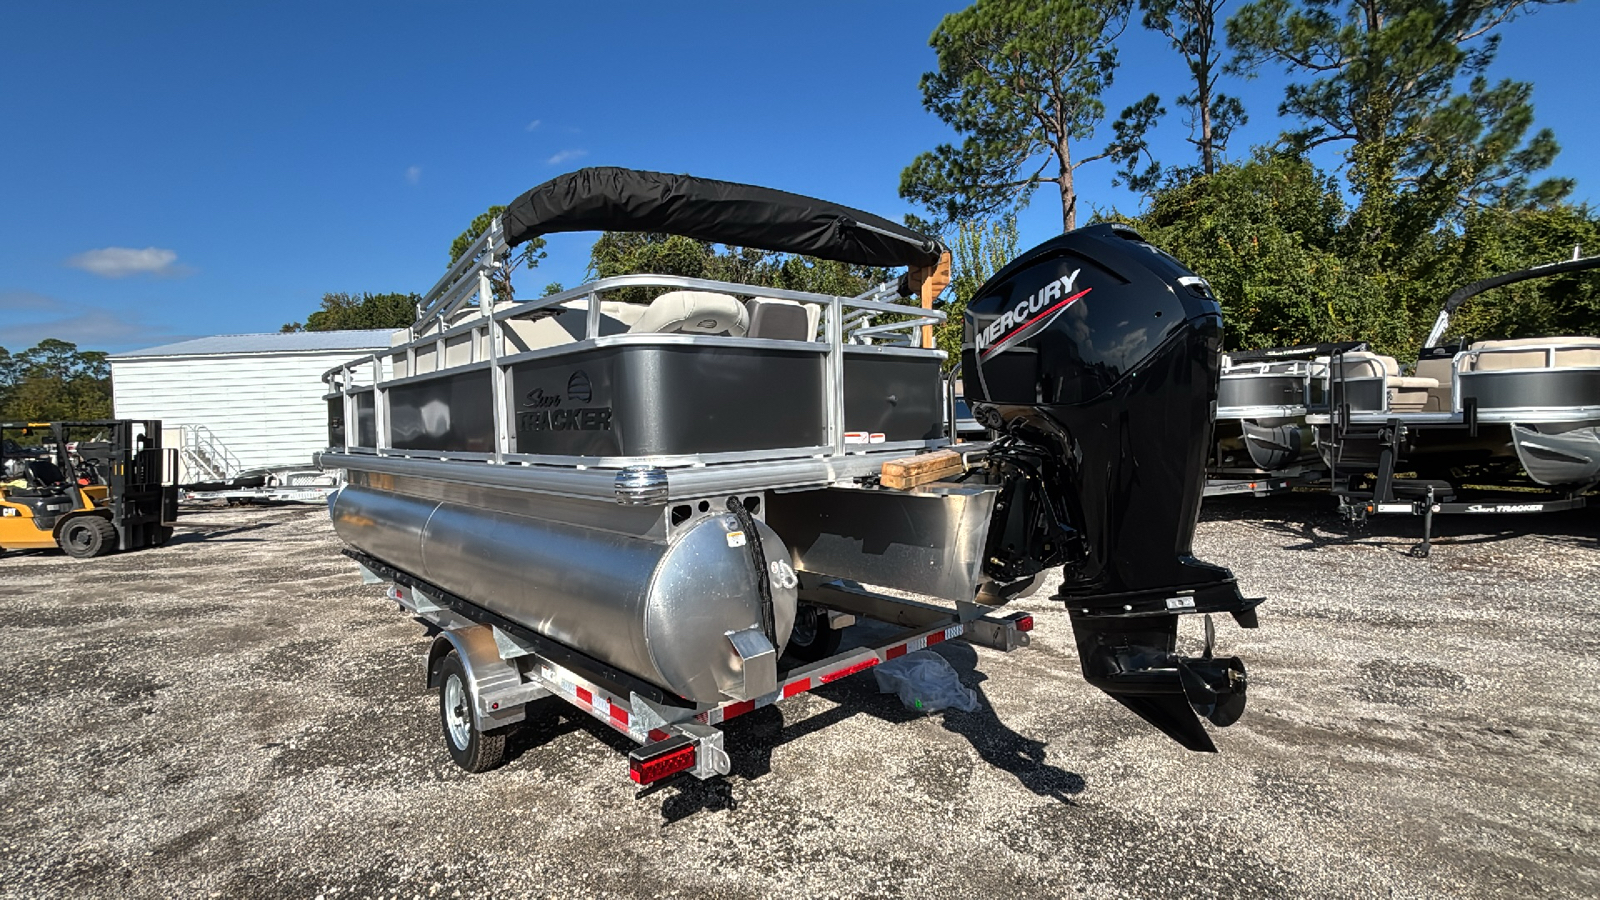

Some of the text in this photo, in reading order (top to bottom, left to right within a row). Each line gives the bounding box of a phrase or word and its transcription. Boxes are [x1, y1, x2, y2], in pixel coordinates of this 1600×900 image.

[976, 268, 1081, 353] MERCURY
[523, 387, 561, 408] Sun
[517, 407, 612, 431] TRACKER
[1464, 504, 1544, 513] Sun TRACKER
